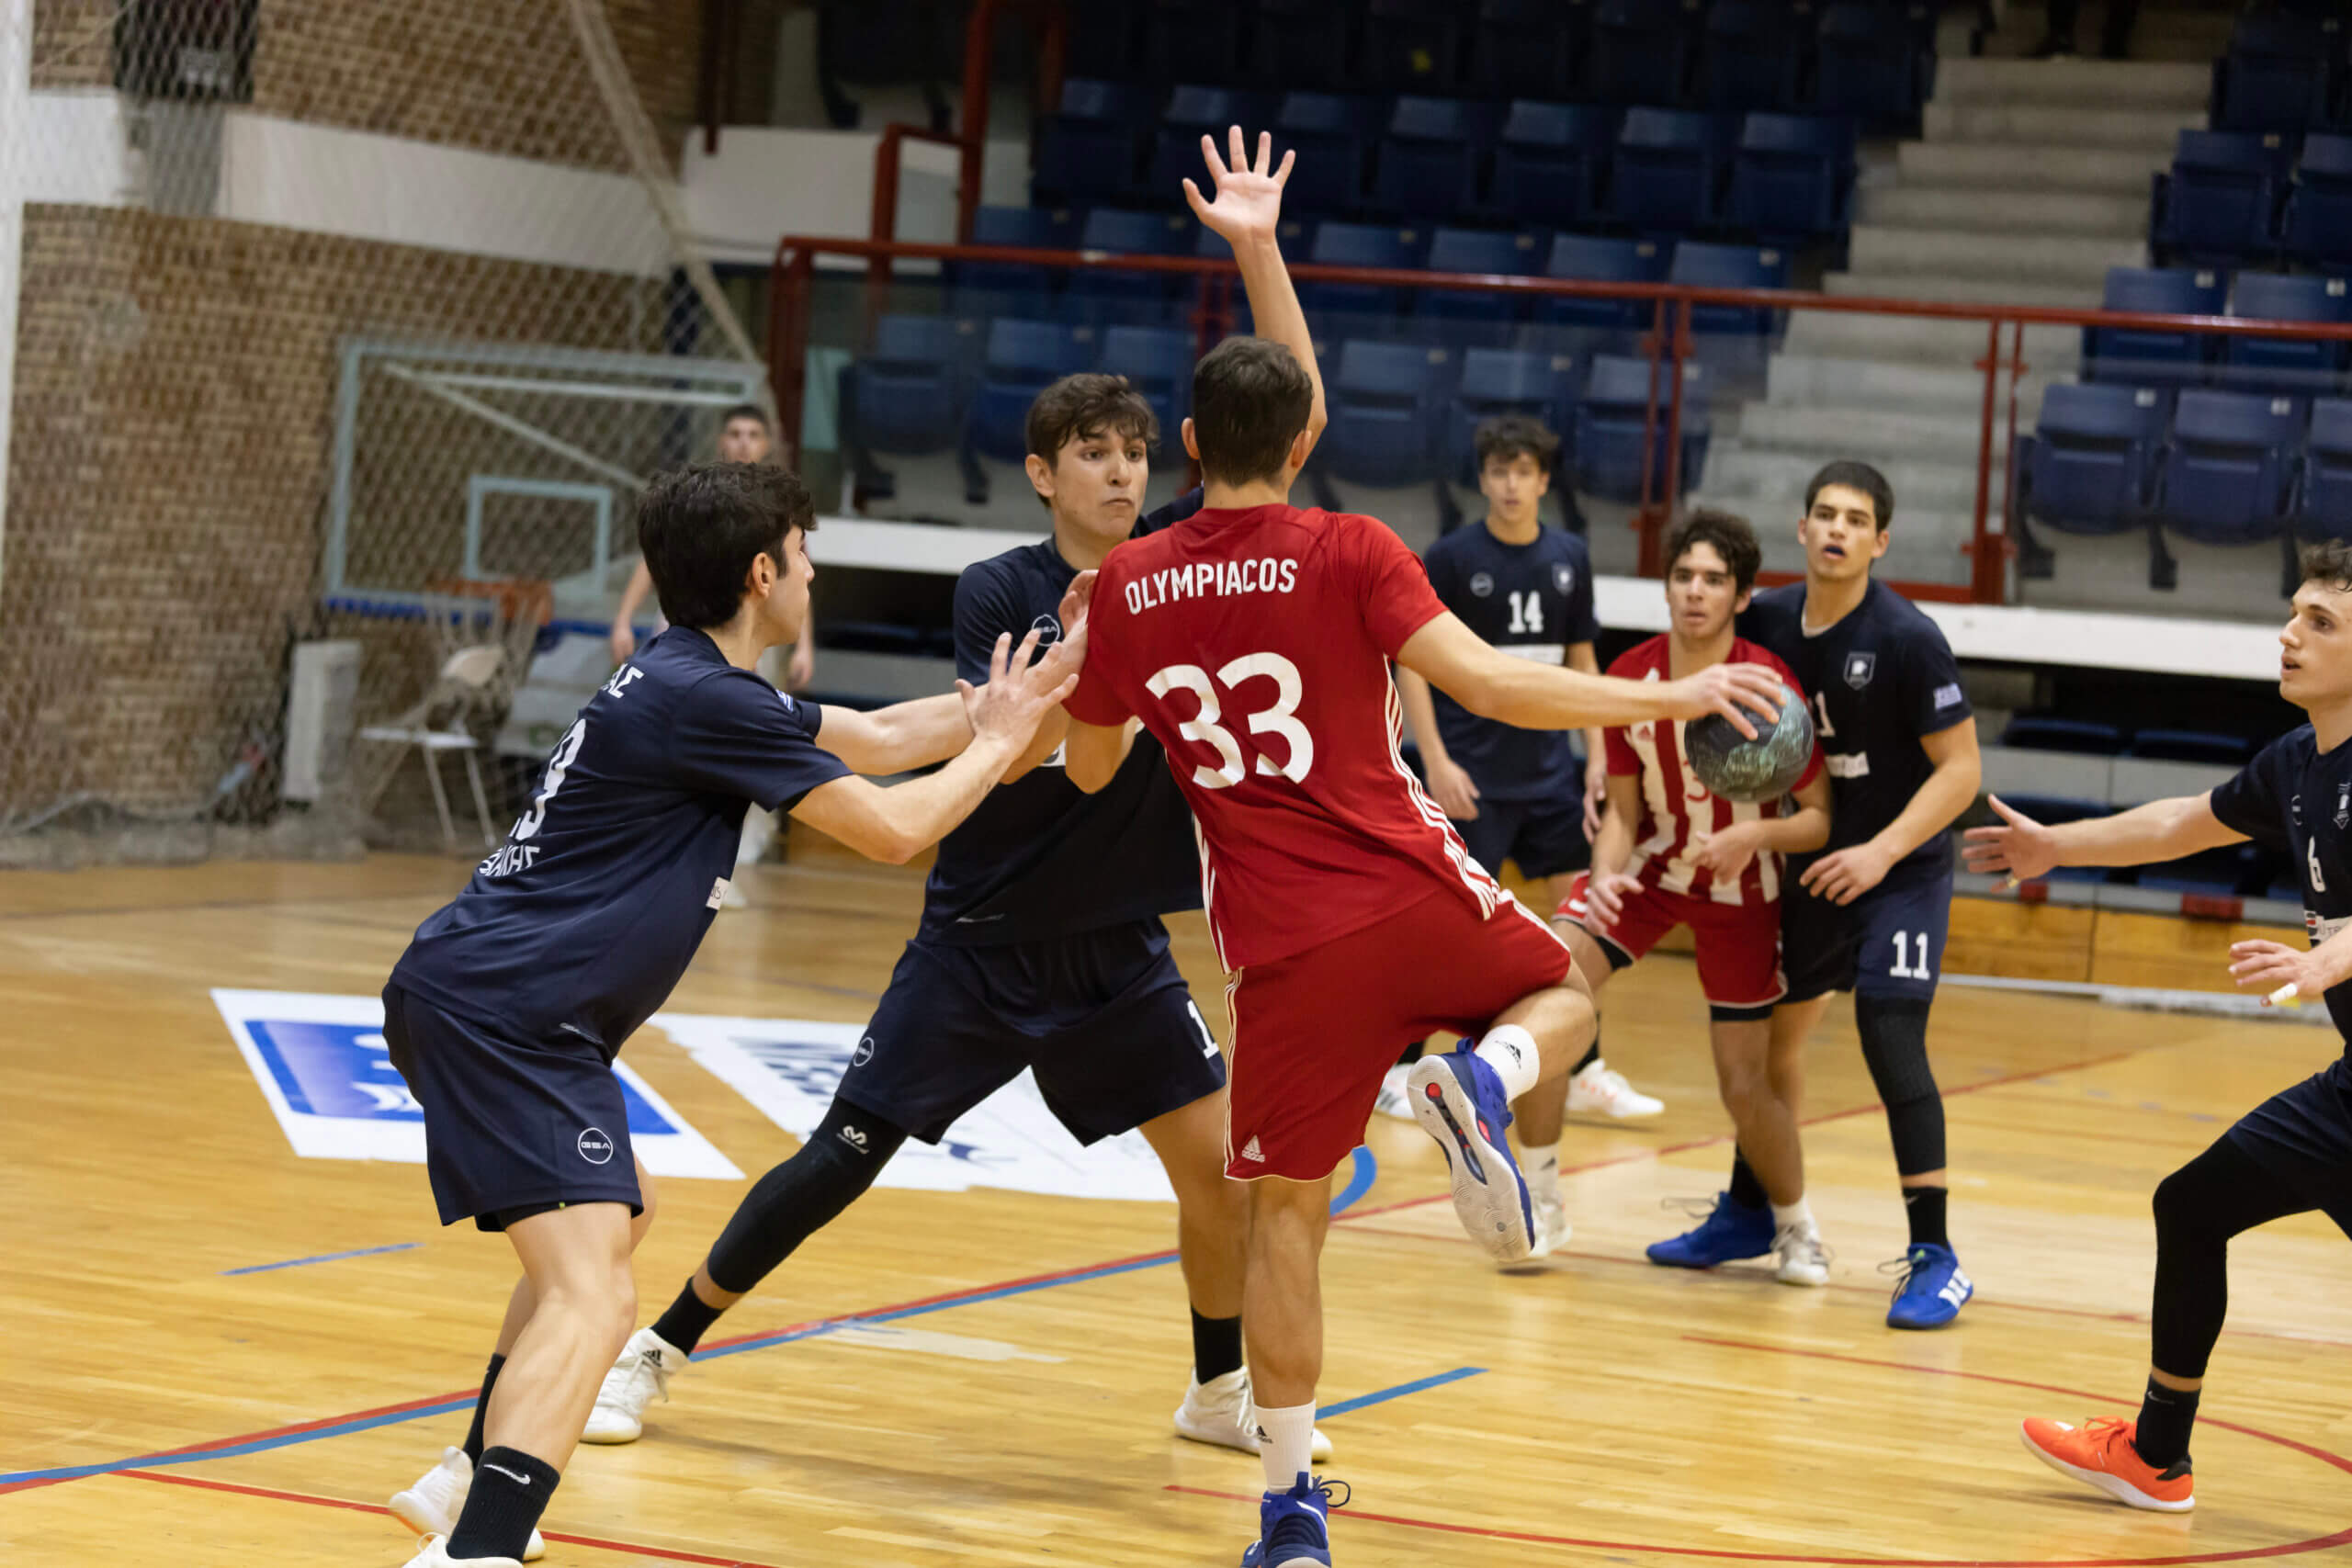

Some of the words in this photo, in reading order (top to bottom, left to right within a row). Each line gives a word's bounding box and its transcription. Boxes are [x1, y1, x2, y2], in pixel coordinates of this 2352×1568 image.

[1125, 558, 1298, 615] OLYMPIACOS
[1508, 590, 1544, 634] 14
[1145, 651, 1314, 789] 33
[2307, 834, 2326, 893] 6
[1889, 930, 1930, 981] 11
[581, 1141, 611, 1150] GSA
